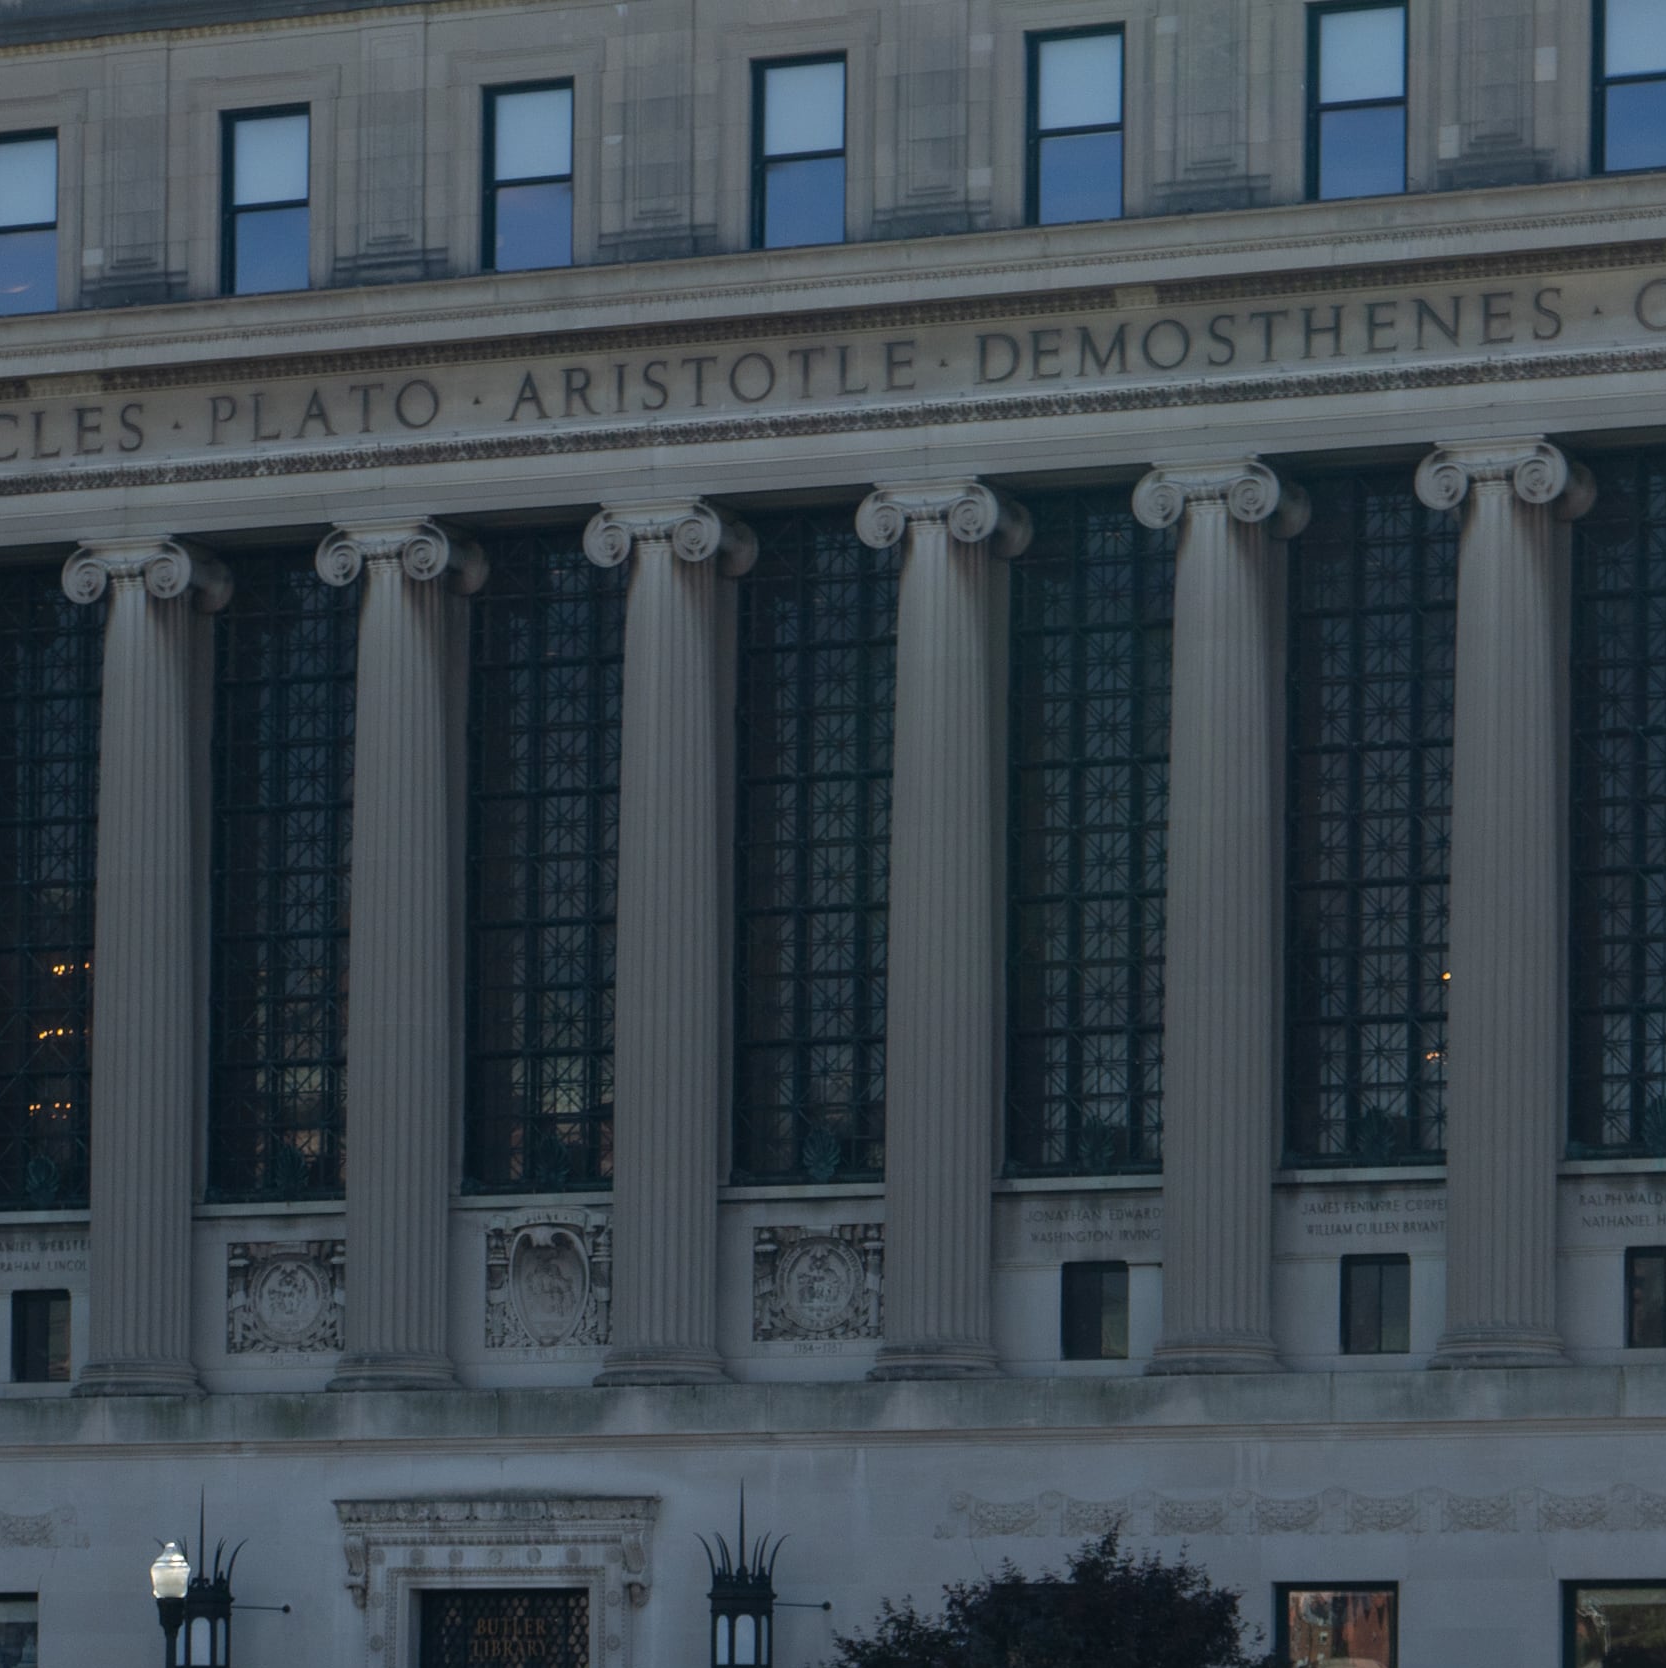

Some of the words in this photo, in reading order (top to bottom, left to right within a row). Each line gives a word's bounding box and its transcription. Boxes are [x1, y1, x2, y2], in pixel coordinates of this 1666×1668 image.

[206, 379, 440, 447] PLATO
[505, 340, 917, 422] ARISTOTLE
[975, 286, 1564, 385] DEMOSTHENES
[1302, 1200, 1339, 1216] JAMES
[1343, 1199, 1400, 1213] FENIMORE
[1578, 1192, 1621, 1207] RALPH
[1025, 1209, 1101, 1224] JONATHAN
[1109, 1206, 1165, 1220] EDWARD
[1582, 1215, 1652, 1228] NATHANIEL
[1031, 1230, 1113, 1243] WASHINGTON
[1119, 1227, 1162, 1241] IRVING
[1308, 1223, 1352, 1237] WILLIAM
[1356, 1221, 1398, 1234] CULLEN
[1403, 1219, 1446, 1232] BRYANT
[477, 1617, 547, 1636] BUTLER
[471, 1638, 549, 1658] LIBRARY
